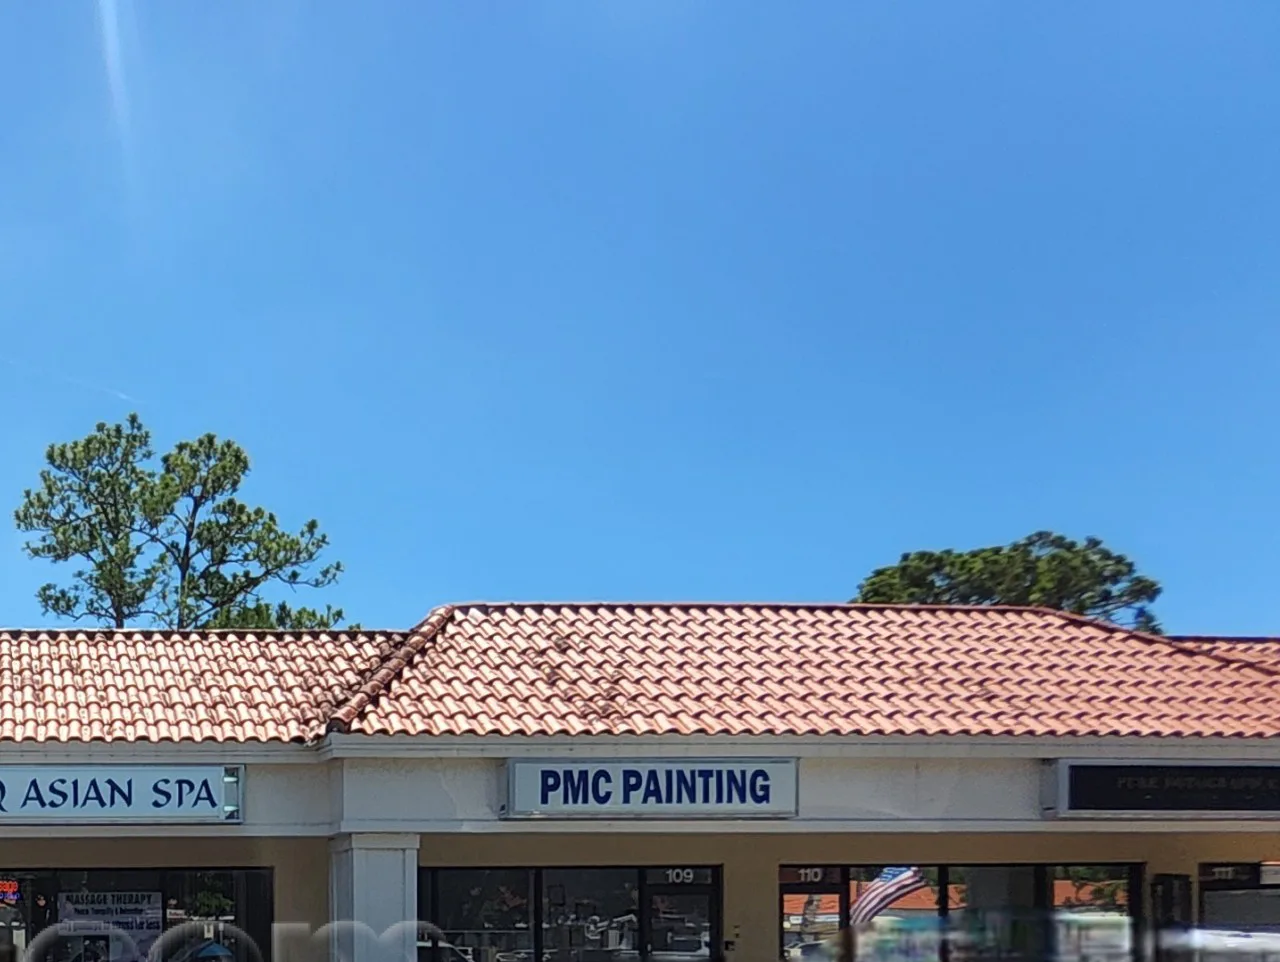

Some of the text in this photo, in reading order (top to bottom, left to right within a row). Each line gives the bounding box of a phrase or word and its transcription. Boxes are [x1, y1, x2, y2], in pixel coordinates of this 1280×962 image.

[20, 777, 132, 809] ASIAN
[151, 777, 218, 809] SPA
[540, 768, 770, 805] PMC PAINTING
[665, 868, 694, 883] 109
[798, 868, 822, 882] 110
[66, 894, 152, 905] MASSAGE THERAPY
